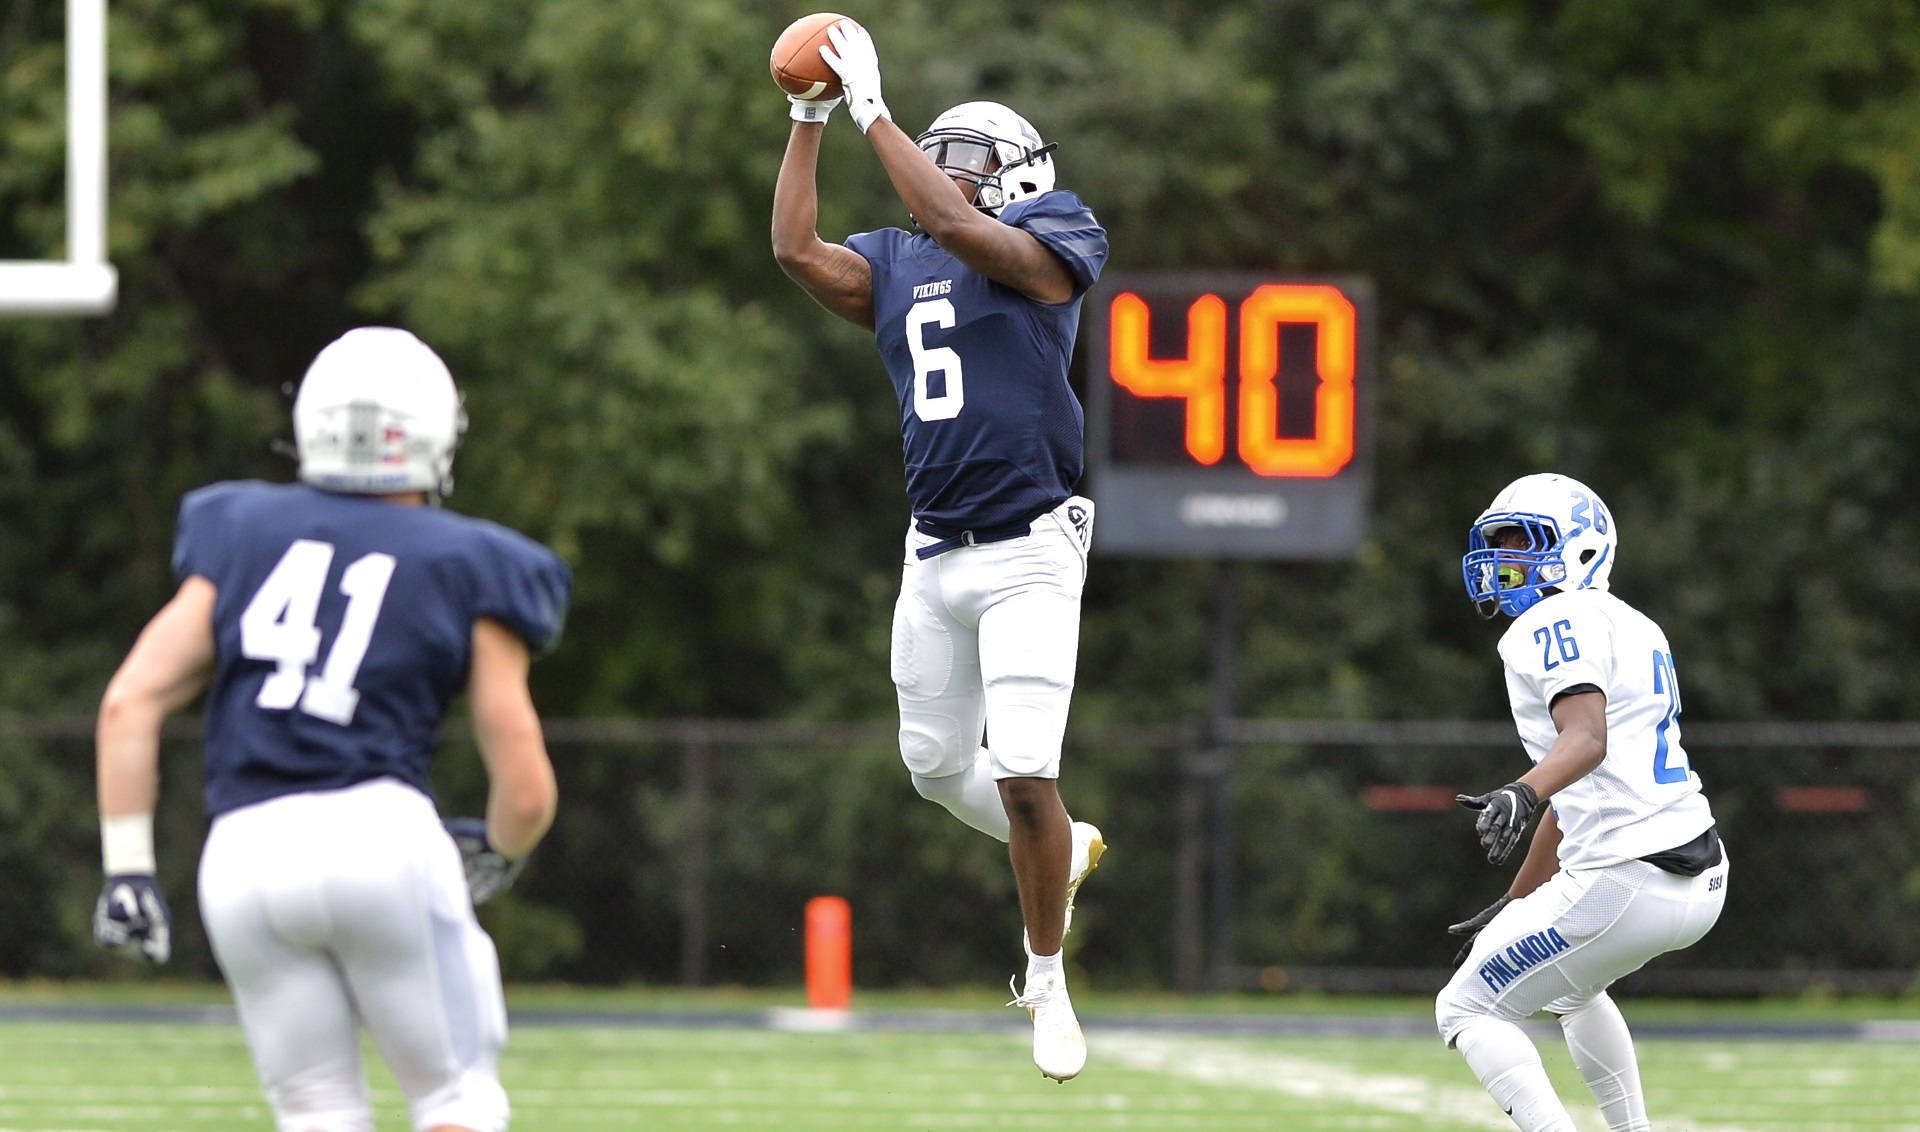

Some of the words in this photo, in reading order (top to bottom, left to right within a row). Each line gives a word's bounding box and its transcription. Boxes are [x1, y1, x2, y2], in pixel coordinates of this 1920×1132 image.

[913, 279, 952, 300] VIKINGS
[906, 298, 965, 422] 6
[1109, 284, 1356, 478] 40
[1570, 490, 1608, 535] 26
[240, 538, 397, 726] 41
[1533, 619, 1580, 671] 26
[1653, 649, 1690, 784] 2
[1479, 926, 1571, 994] FINLANDIA
